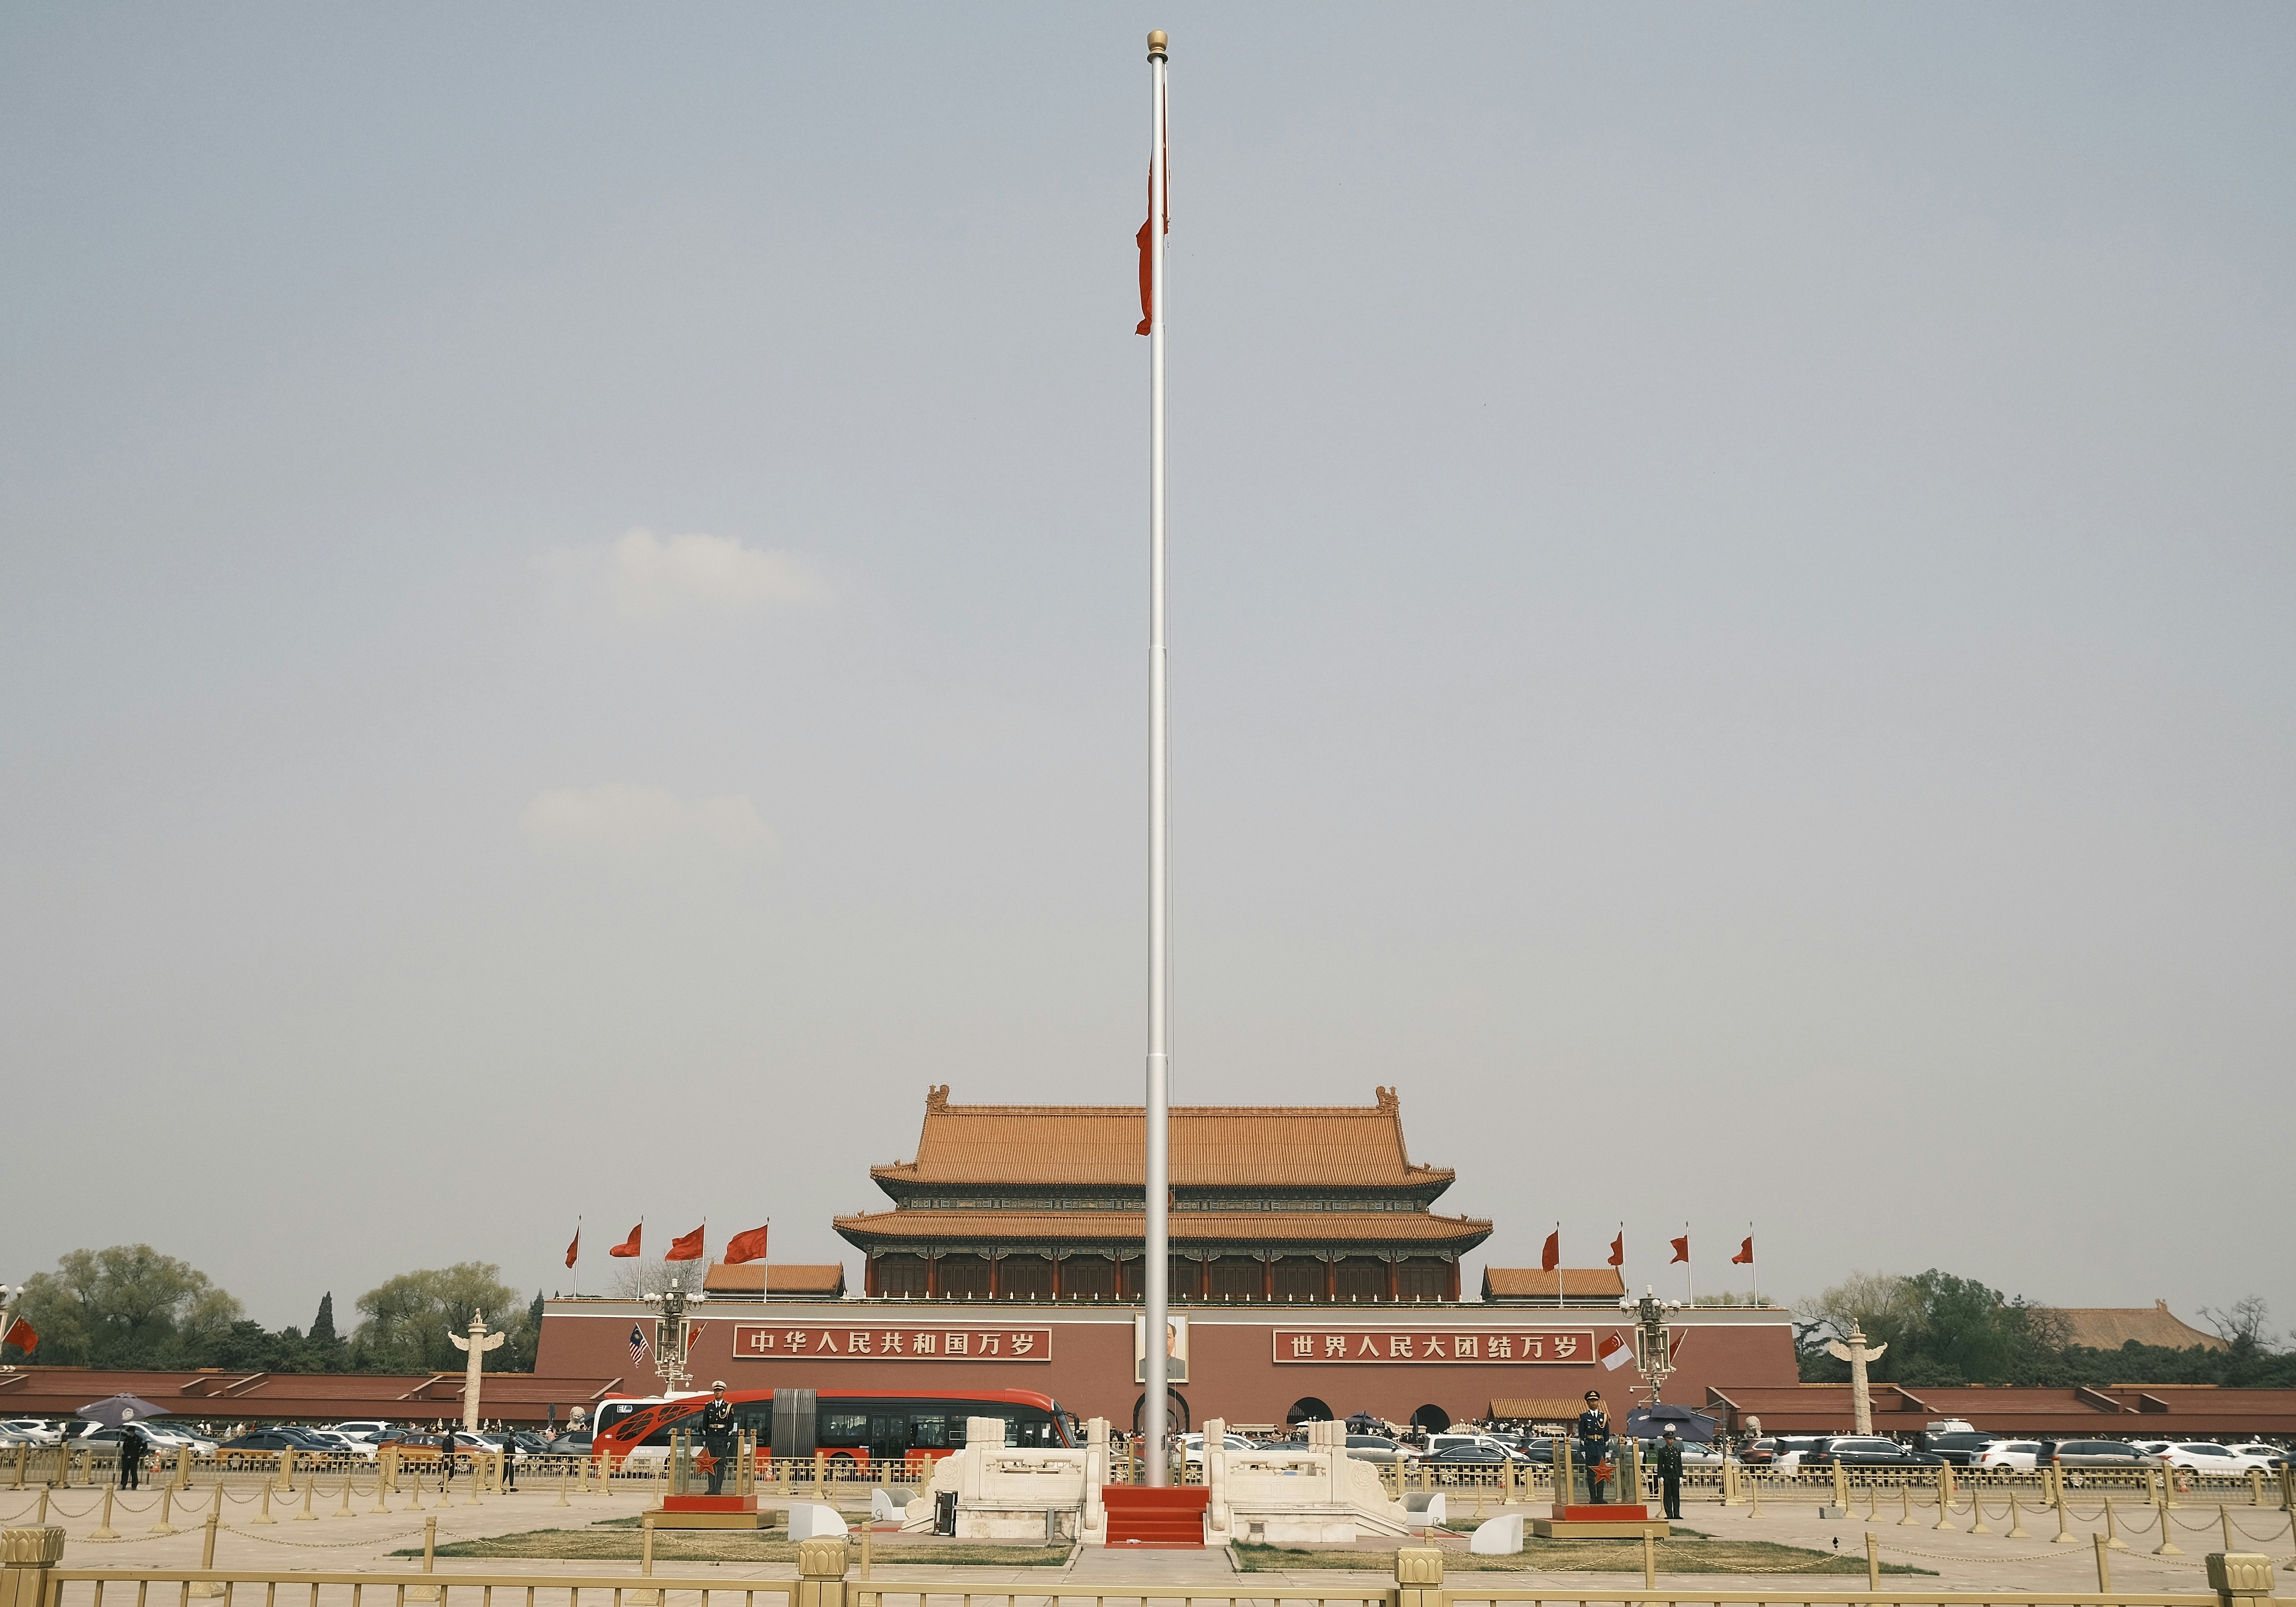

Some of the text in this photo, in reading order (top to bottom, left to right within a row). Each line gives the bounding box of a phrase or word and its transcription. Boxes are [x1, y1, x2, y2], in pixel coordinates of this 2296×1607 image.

[750, 1330, 1034, 1356] 中华人民共和国万岁
[1291, 1335, 1578, 1358] 世界人民大团结万岁
